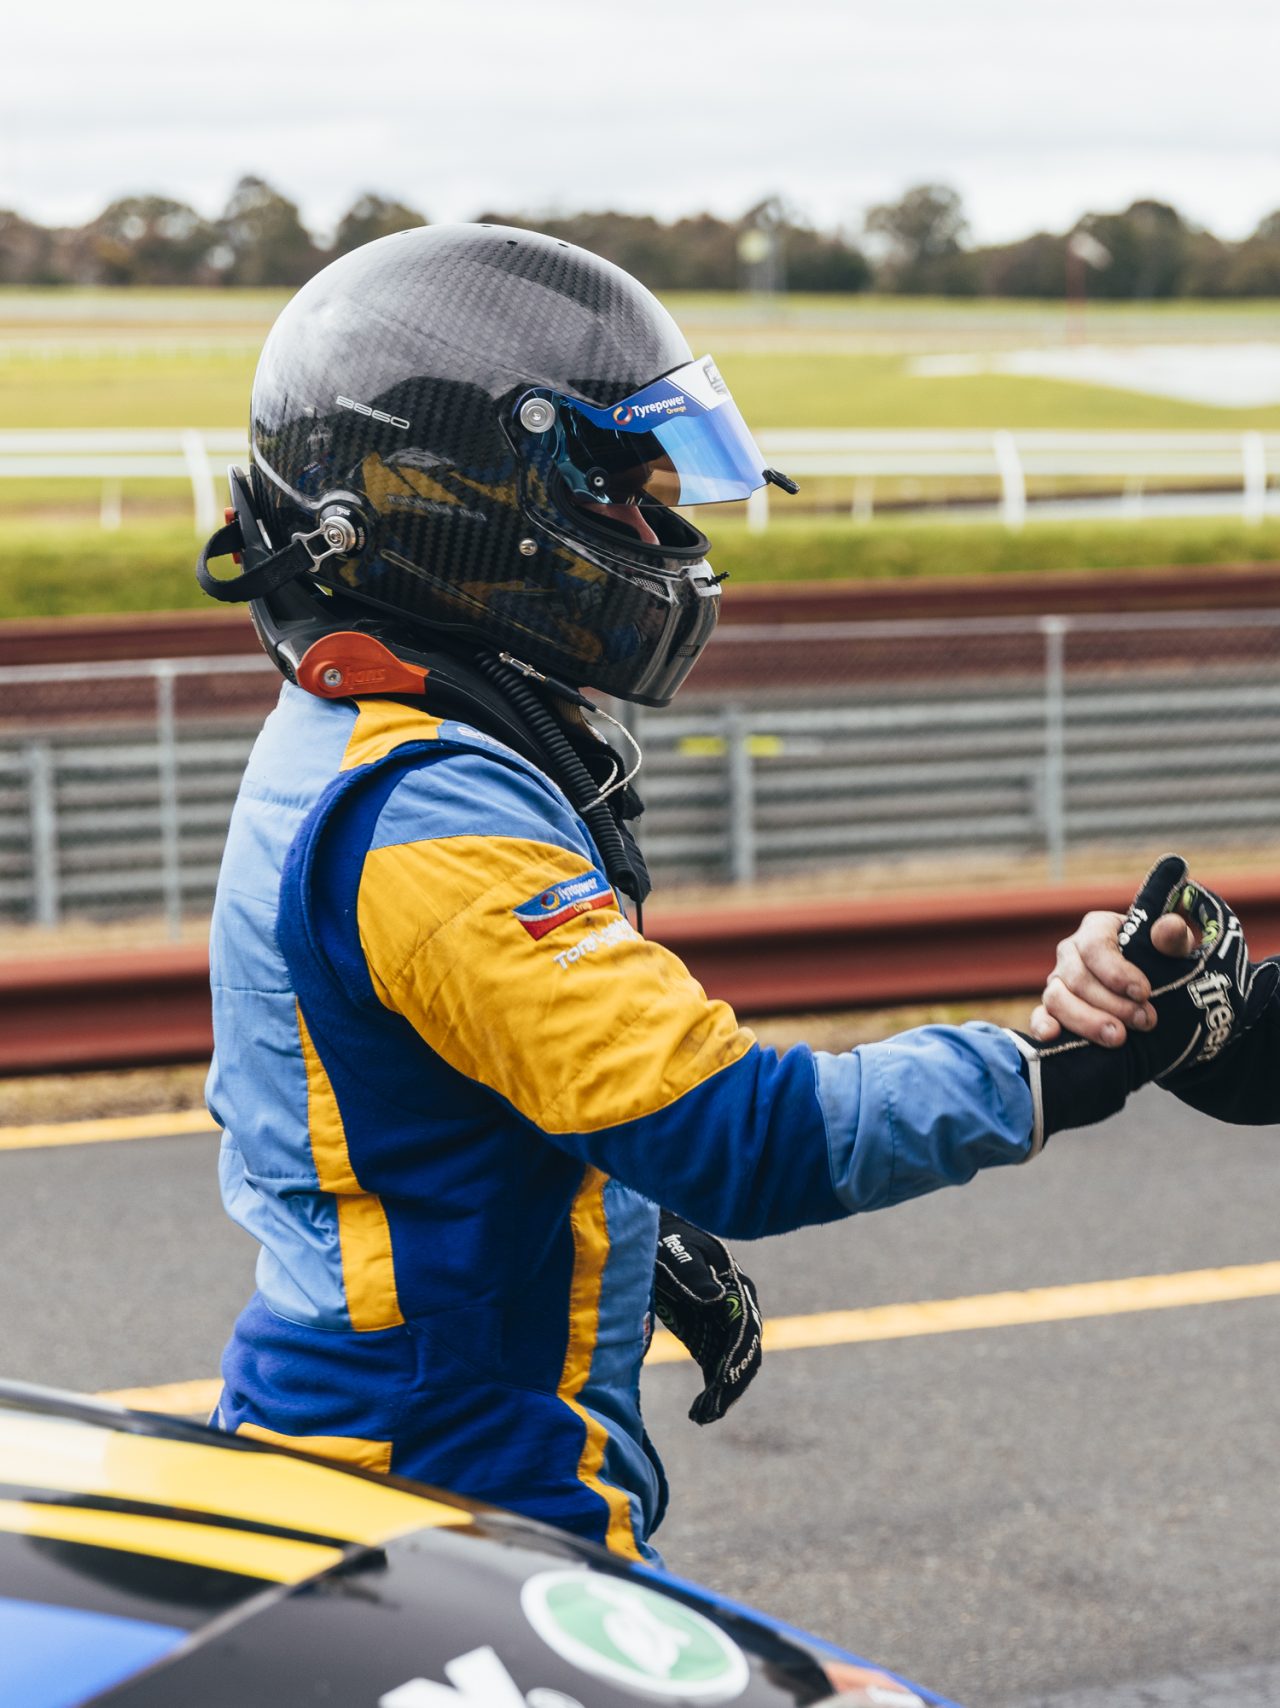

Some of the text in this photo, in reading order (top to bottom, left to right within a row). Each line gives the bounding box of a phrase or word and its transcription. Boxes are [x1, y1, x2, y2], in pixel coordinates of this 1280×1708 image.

[632, 395, 685, 418] Tyrepower
[666, 405, 687, 415] Orange
[1118, 906, 1148, 952] free
[662, 1233, 693, 1263] freem
